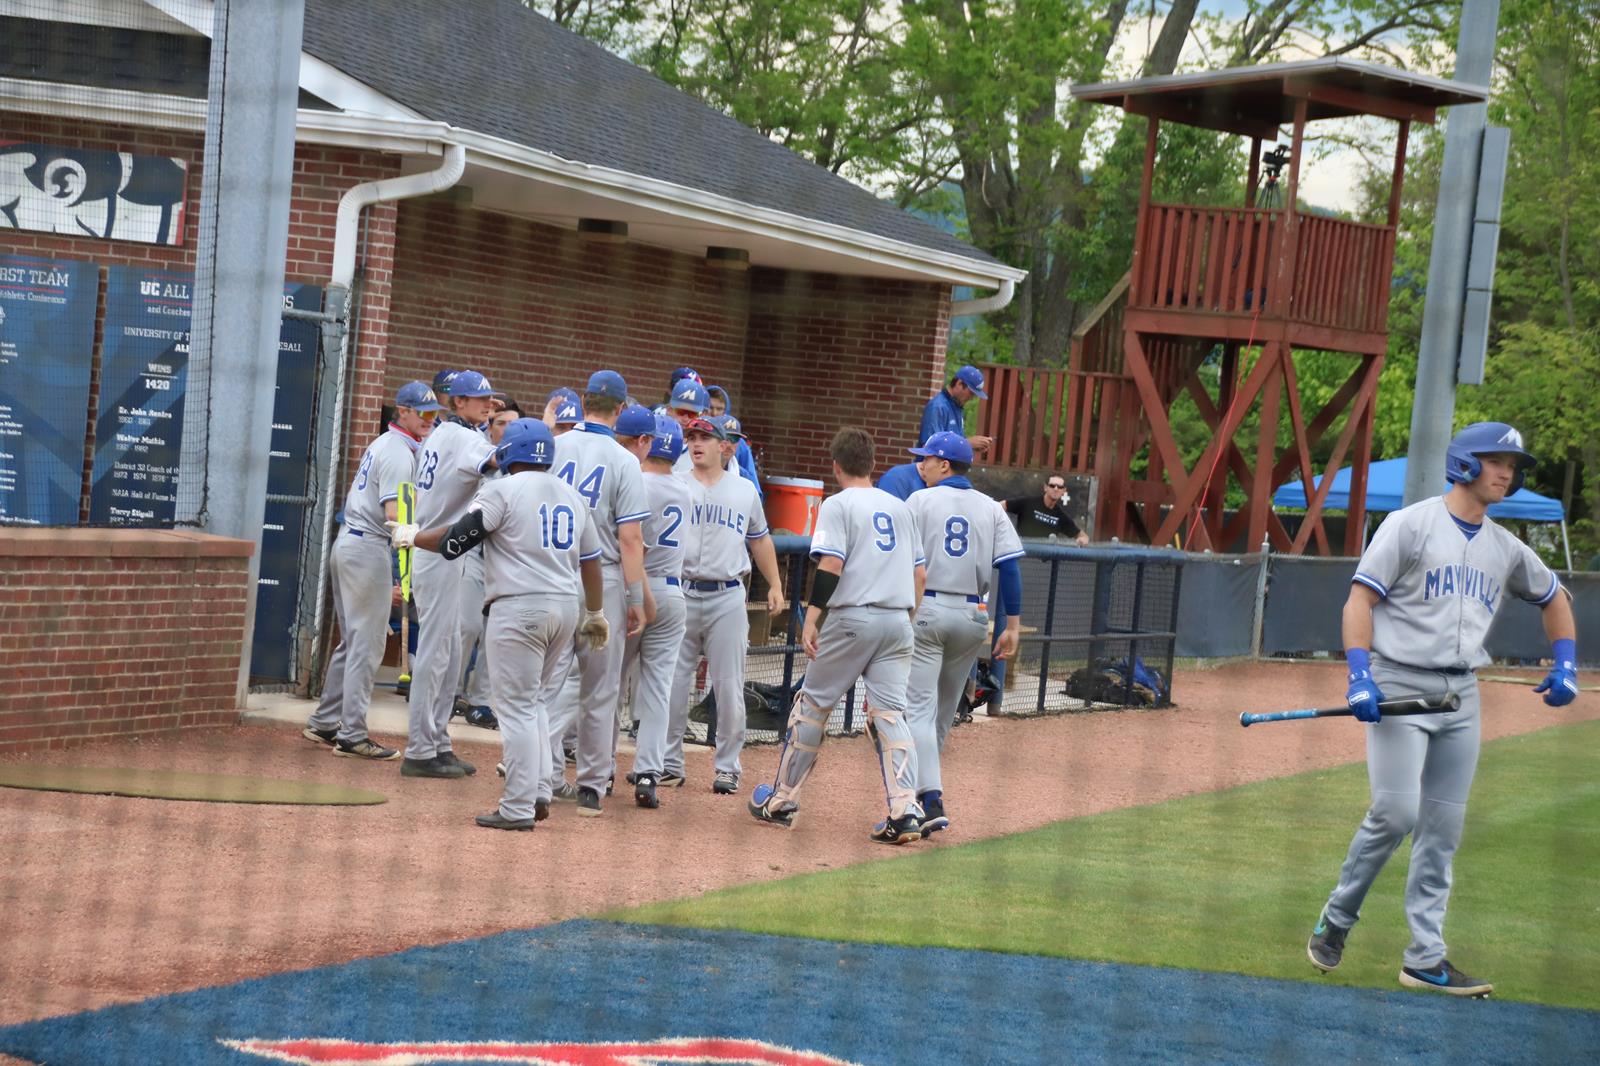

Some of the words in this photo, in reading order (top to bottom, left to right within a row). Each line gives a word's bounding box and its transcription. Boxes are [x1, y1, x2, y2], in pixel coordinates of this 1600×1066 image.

[29, 269, 69, 287] TEAM
[140, 280, 160, 296] UC
[163, 284, 189, 299] ALL
[124, 326, 172, 339] UNIVERSITY
[173, 331, 184, 341] OF
[148, 363, 172, 373] WINS
[145, 379, 170, 390] 1420
[112, 488, 129, 498] NAIA
[130, 490, 143, 500] Hall
[538, 502, 575, 551] 10
[656, 504, 683, 548] 2
[872, 510, 897, 553] 9
[943, 514, 970, 558] 8
